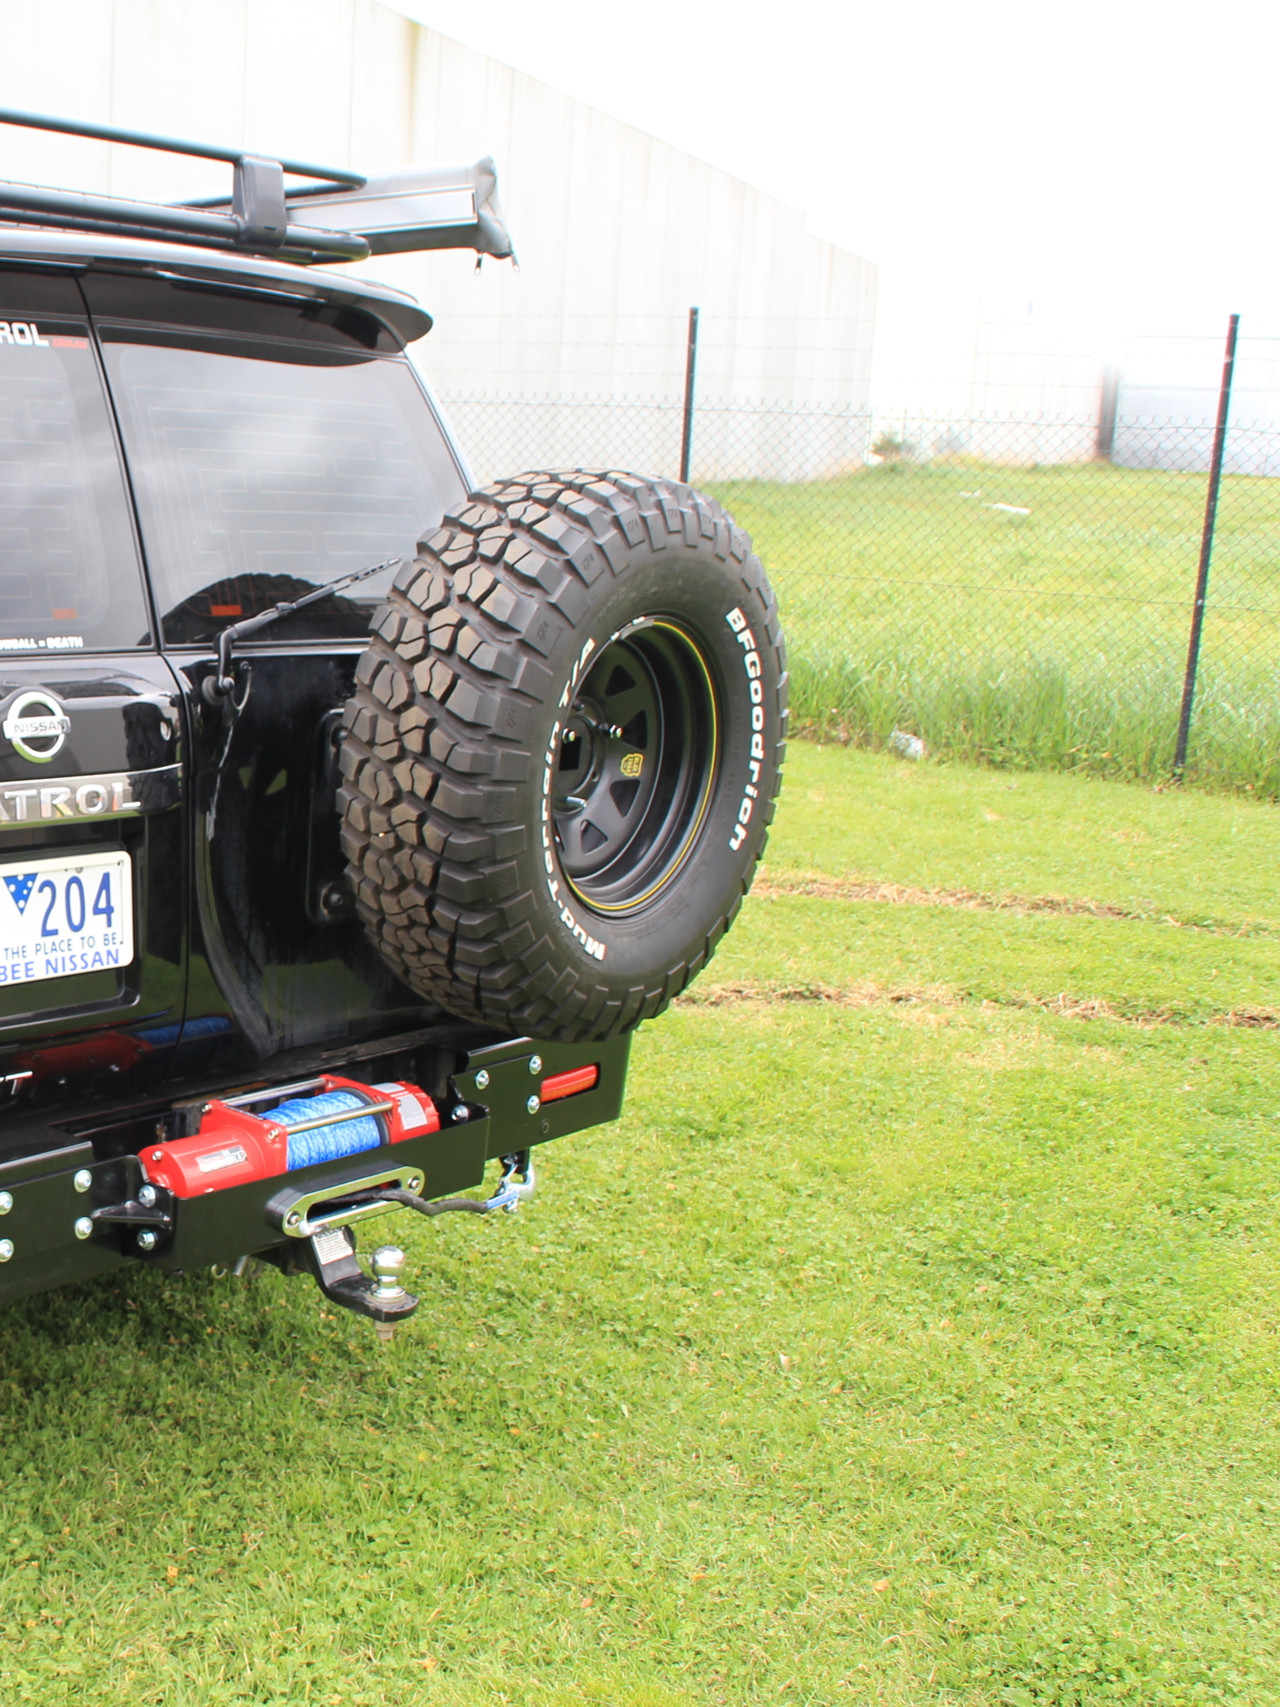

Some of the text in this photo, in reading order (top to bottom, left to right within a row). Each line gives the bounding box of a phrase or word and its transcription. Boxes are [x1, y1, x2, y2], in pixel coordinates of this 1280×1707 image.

[46, 636, 84, 649] DEATH
[14, 719, 67, 734] NISSAN
[725, 607, 765, 851] BFGoodrich
[37, 871, 115, 938] 204
[3, 945, 28, 961] THE
[34, 938, 73, 956] PLACE
[79, 935, 96, 949] TO
[103, 932, 118, 946] BE
[45, 948, 120, 976] NISSAN
